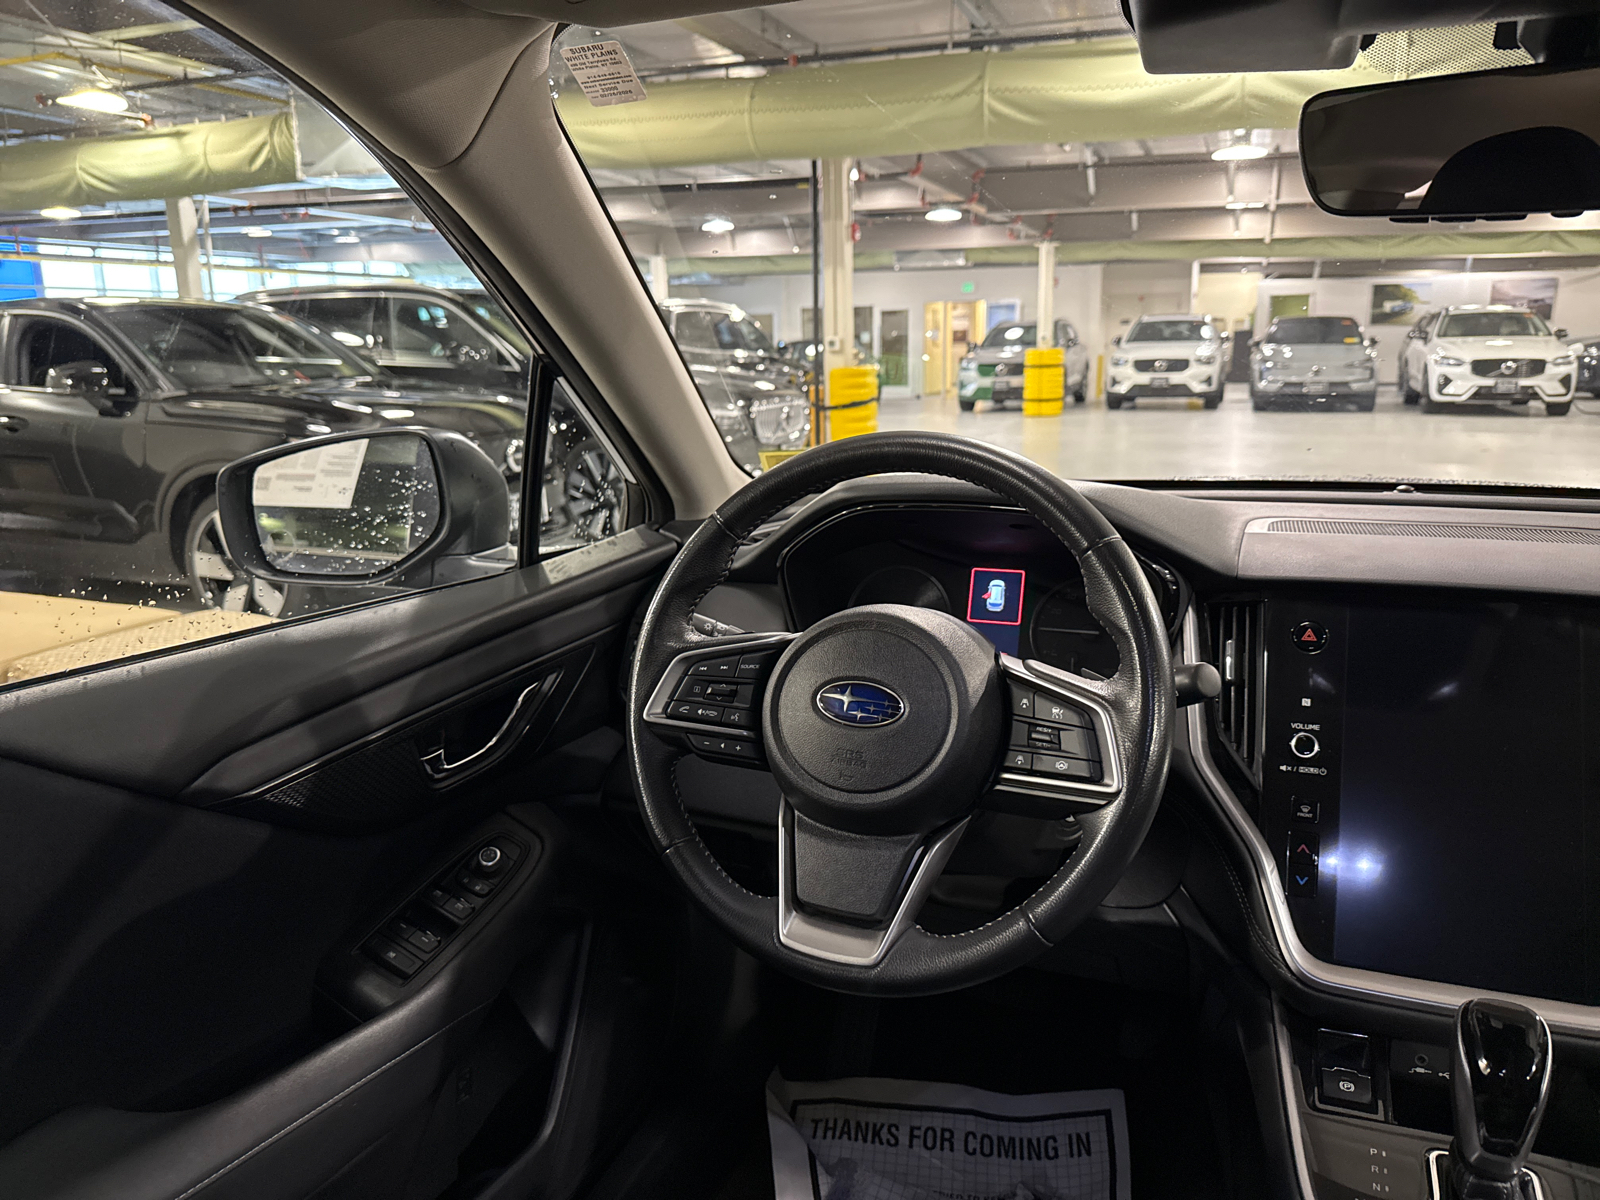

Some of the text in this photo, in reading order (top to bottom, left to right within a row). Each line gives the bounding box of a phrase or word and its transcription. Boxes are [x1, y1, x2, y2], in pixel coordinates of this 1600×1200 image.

[569, 43, 604, 55] SUBARU
[564, 49, 619, 63] WHITE PLAINS
[1290, 722, 1321, 731] VOLUME
[811, 1118, 1092, 1161] THANKS FOR COMING IN
[1370, 1148, 1378, 1156] P
[1370, 1164, 1380, 1174] R
[1372, 1182, 1381, 1192] N
